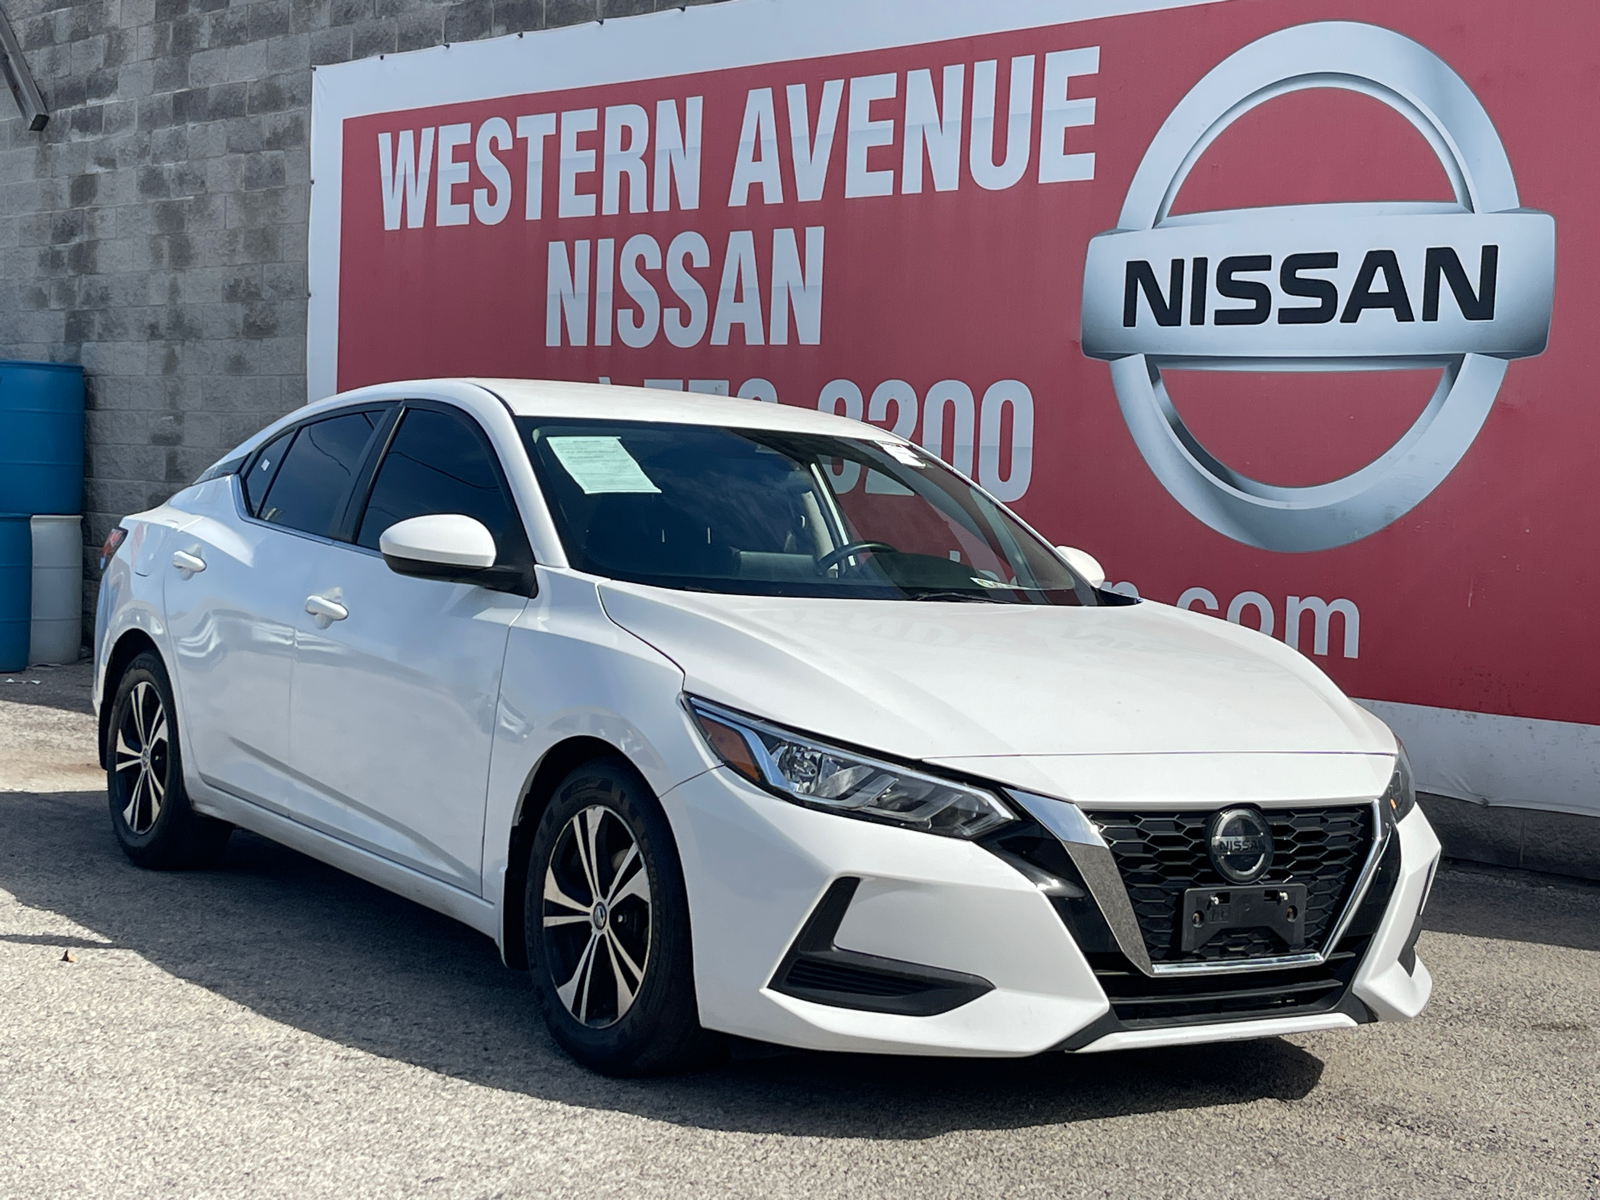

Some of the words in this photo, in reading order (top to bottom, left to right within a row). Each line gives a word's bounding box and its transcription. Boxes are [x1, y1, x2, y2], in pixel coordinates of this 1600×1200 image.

[378, 95, 704, 231] WESTERN
[727, 46, 1101, 208] AVENUE
[545, 226, 826, 349] NISSAN
[1122, 244, 1499, 328] NISSAN
[1219, 839, 1265, 852] NISSAN
